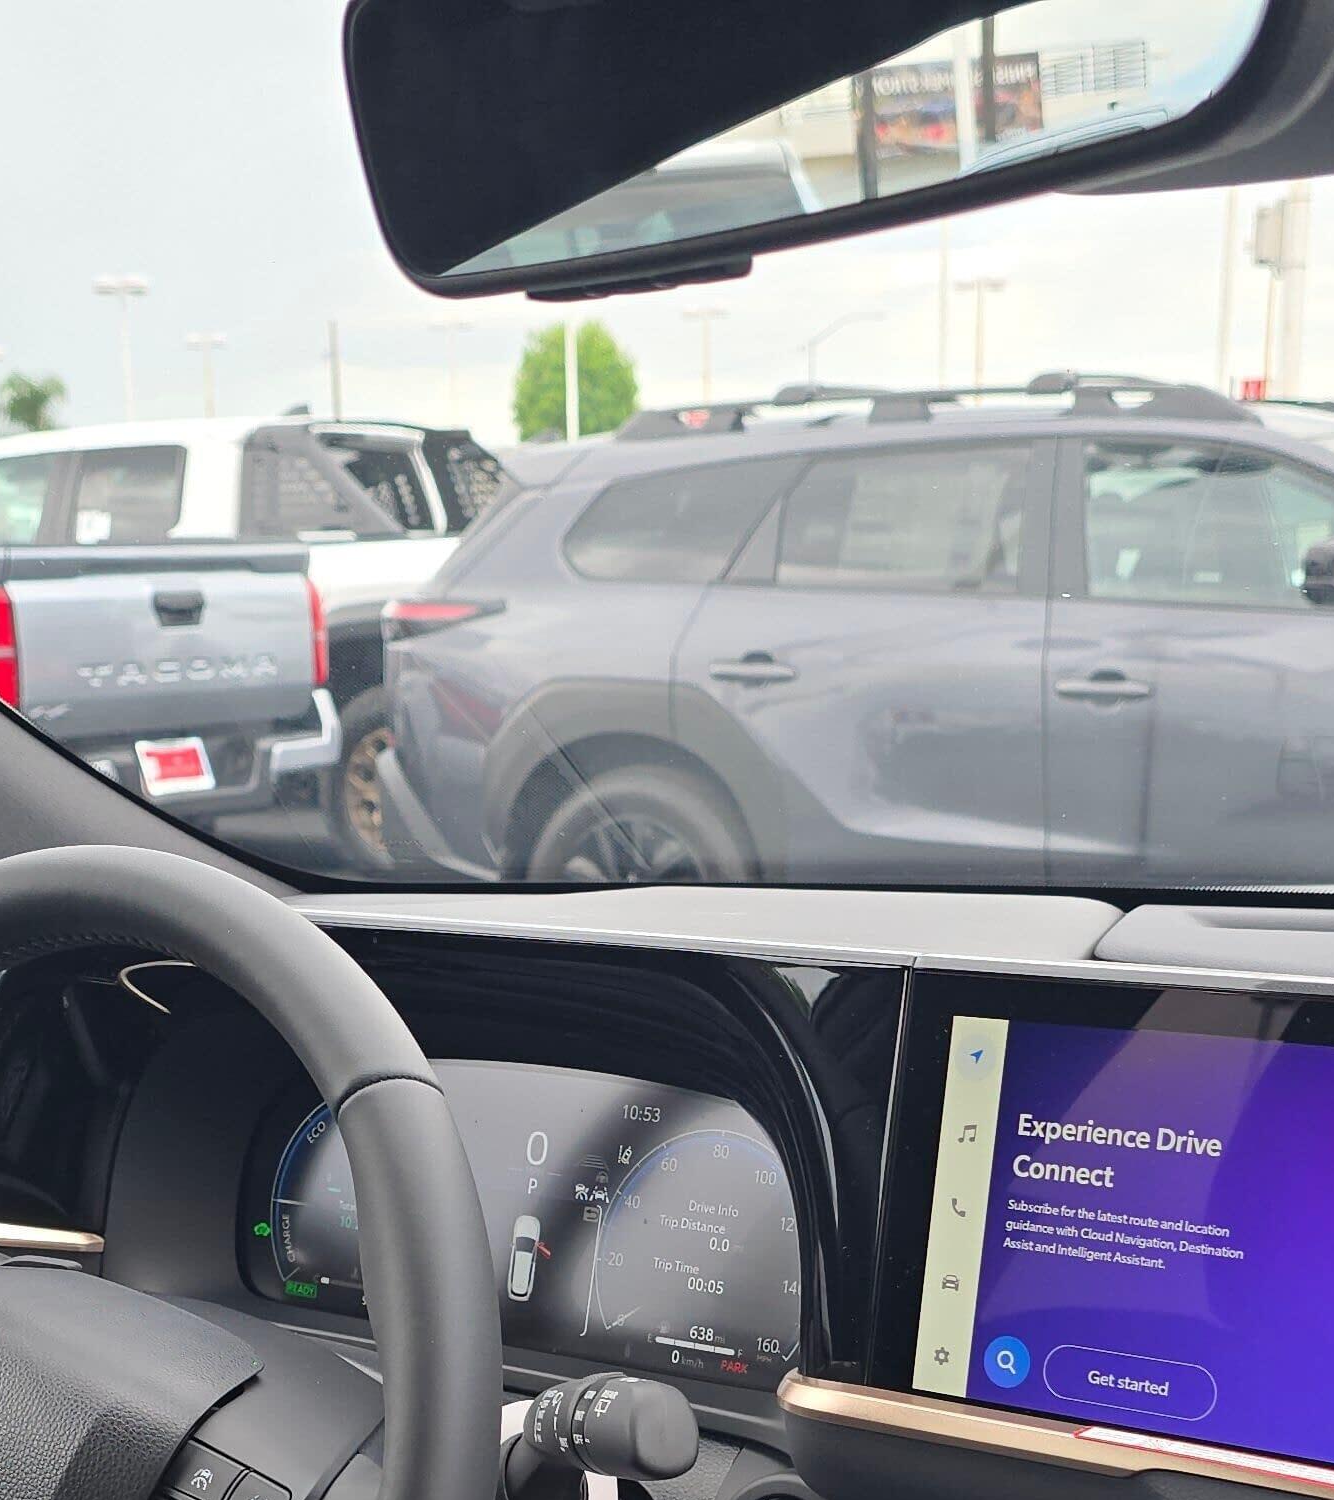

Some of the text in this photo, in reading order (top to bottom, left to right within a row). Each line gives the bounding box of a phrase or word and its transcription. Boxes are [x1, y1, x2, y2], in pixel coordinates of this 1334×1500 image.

[622, 1104, 661, 1123] 10:53
[306, 1120, 327, 1144] ECO
[1017, 1113, 1223, 1157] Experience Drive
[526, 1131, 548, 1166] 0
[713, 1144, 730, 1159] 80
[660, 1157, 678, 1172] 60
[1012, 1155, 1115, 1188] Connect
[527, 1178, 539, 1195] P
[754, 1170, 777, 1186] 100
[624, 1195, 641, 1209] 40
[688, 1200, 739, 1218] Drive Info
[659, 1214, 726, 1234] Trip Distance
[780, 1216, 796, 1233] 12
[1007, 1199, 1231, 1238] Subscribe for the latest route and location
[281, 1213, 296, 1264] CHARGE
[708, 1236, 730, 1252] 0.0
[1004, 1219, 1245, 1260] guidance with Cloud Navigation, Destination
[607, 1251, 624, 1267] 20
[1002, 1237, 1166, 1270] Assist and Intelligent Assistant.
[652, 1256, 700, 1275] Trip Time
[687, 1276, 724, 1295] 00:05
[689, 1325, 714, 1342] 638
[756, 1336, 778, 1354] 160
[671, 1350, 704, 1369] 0 km/h
[720, 1359, 748, 1375] PARK
[1087, 1370, 1169, 1397] Get started
